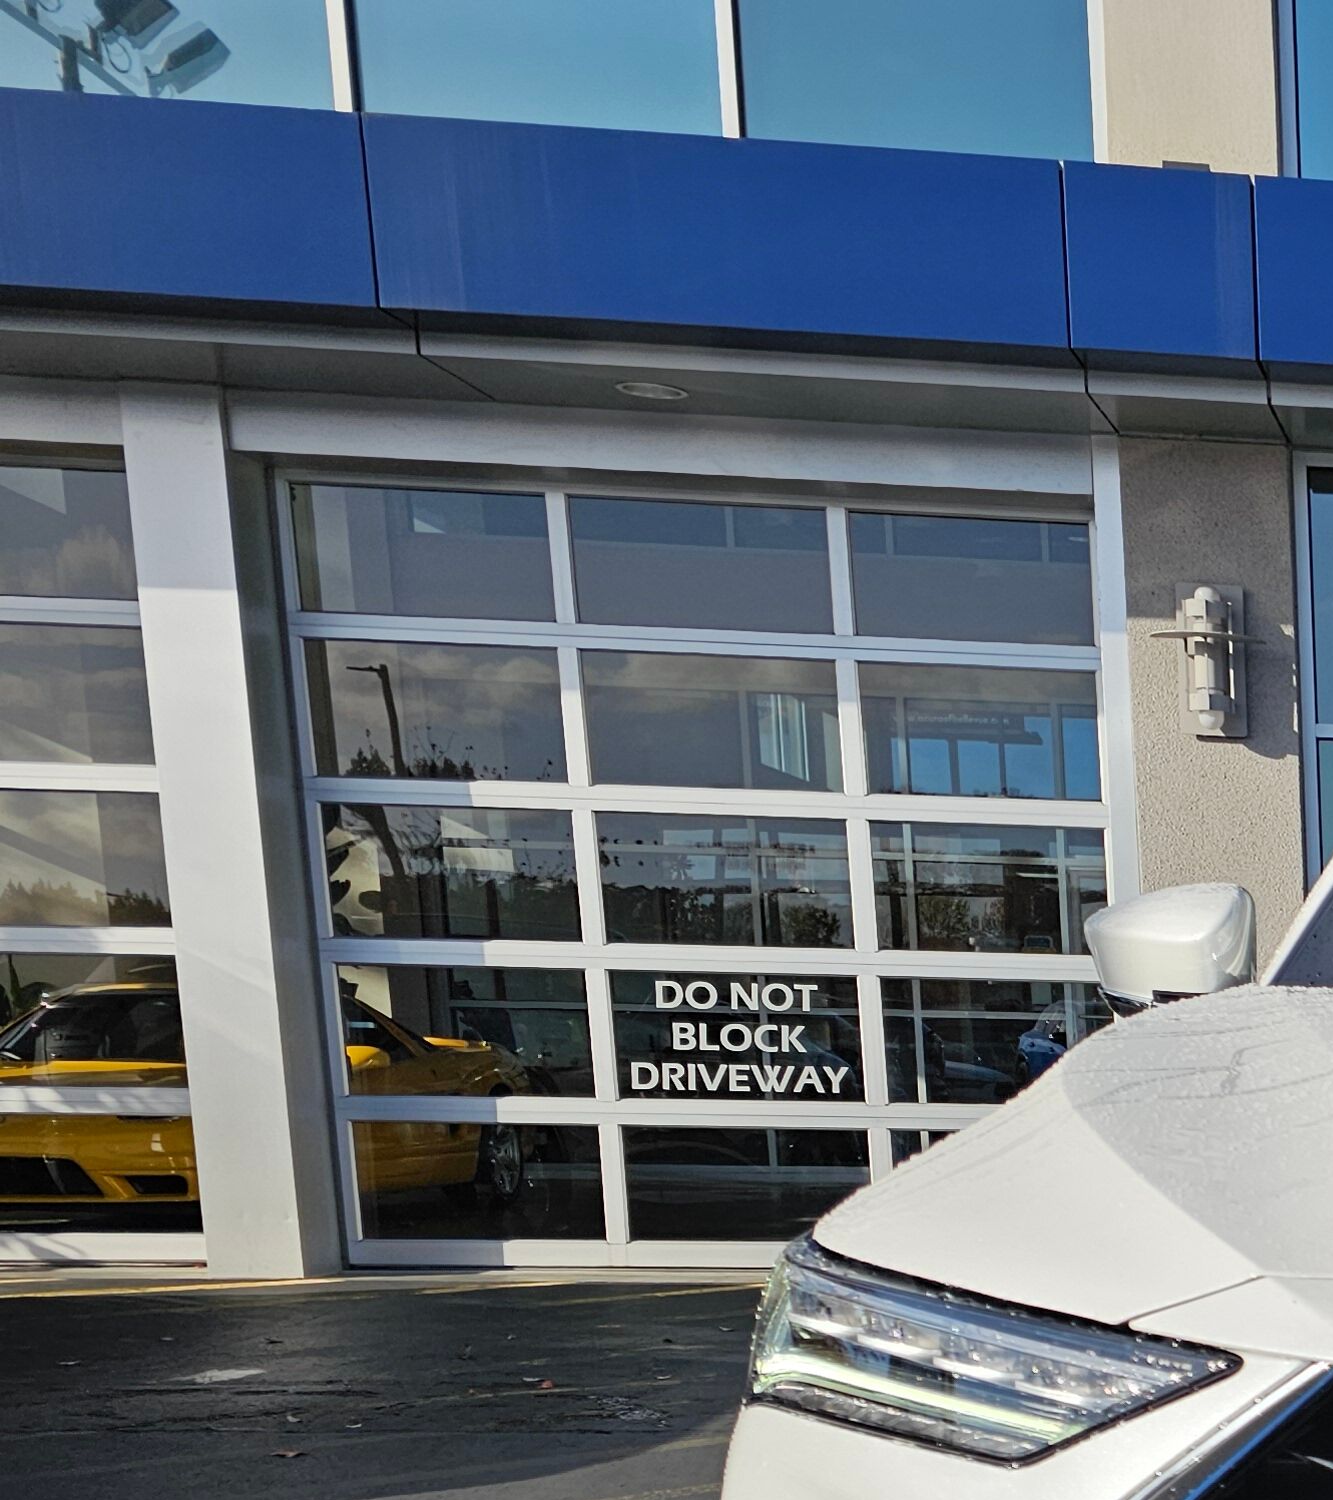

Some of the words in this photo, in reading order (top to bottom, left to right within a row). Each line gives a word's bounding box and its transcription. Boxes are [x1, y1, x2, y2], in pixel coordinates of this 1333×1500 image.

[654, 980, 719, 1010] DO
[730, 982, 819, 1012] NOT
[671, 1022, 808, 1053] BLOCK
[630, 1061, 850, 1094] DRIVEWAY
